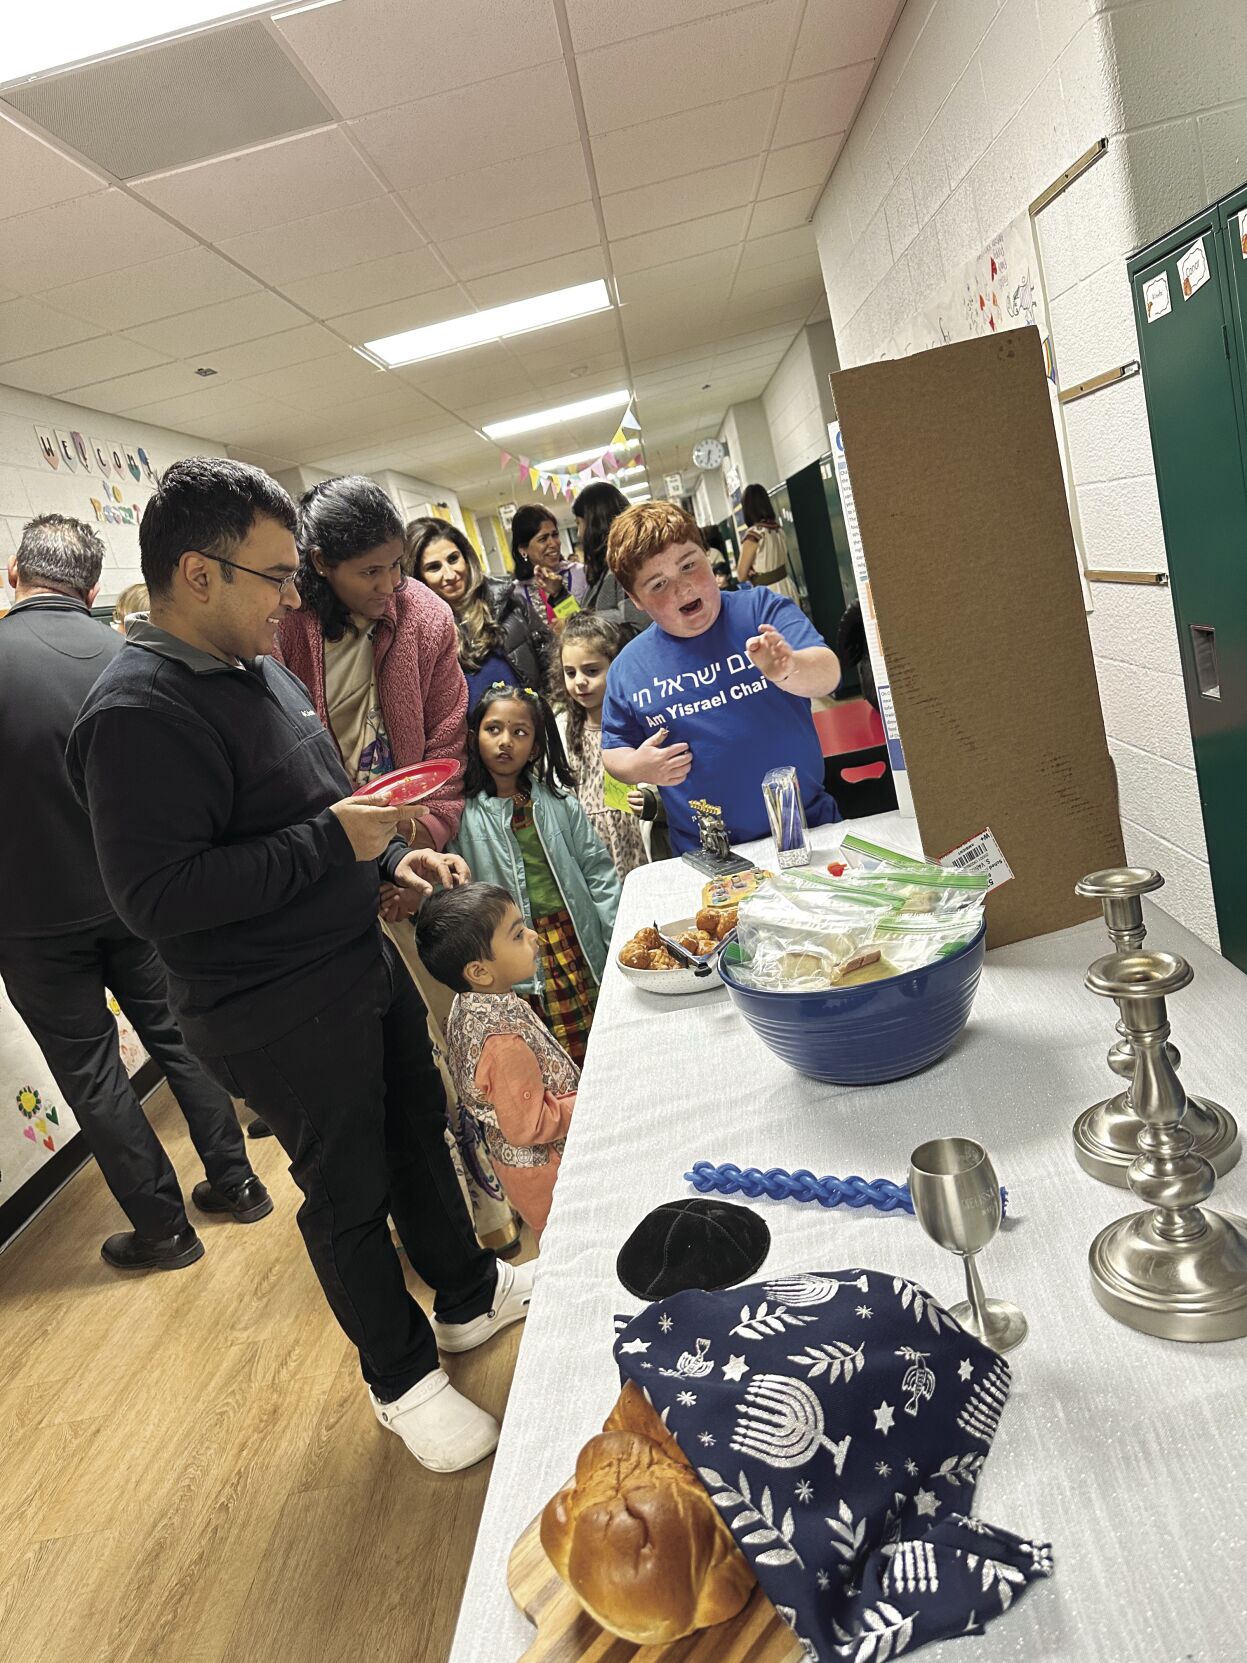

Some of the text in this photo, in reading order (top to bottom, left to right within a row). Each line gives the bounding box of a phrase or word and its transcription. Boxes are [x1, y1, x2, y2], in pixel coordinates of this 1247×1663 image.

[632, 686, 652, 708] חי
[653, 662, 721, 698] ישראל
[645, 676, 769, 728] Am Yisrael Chai
